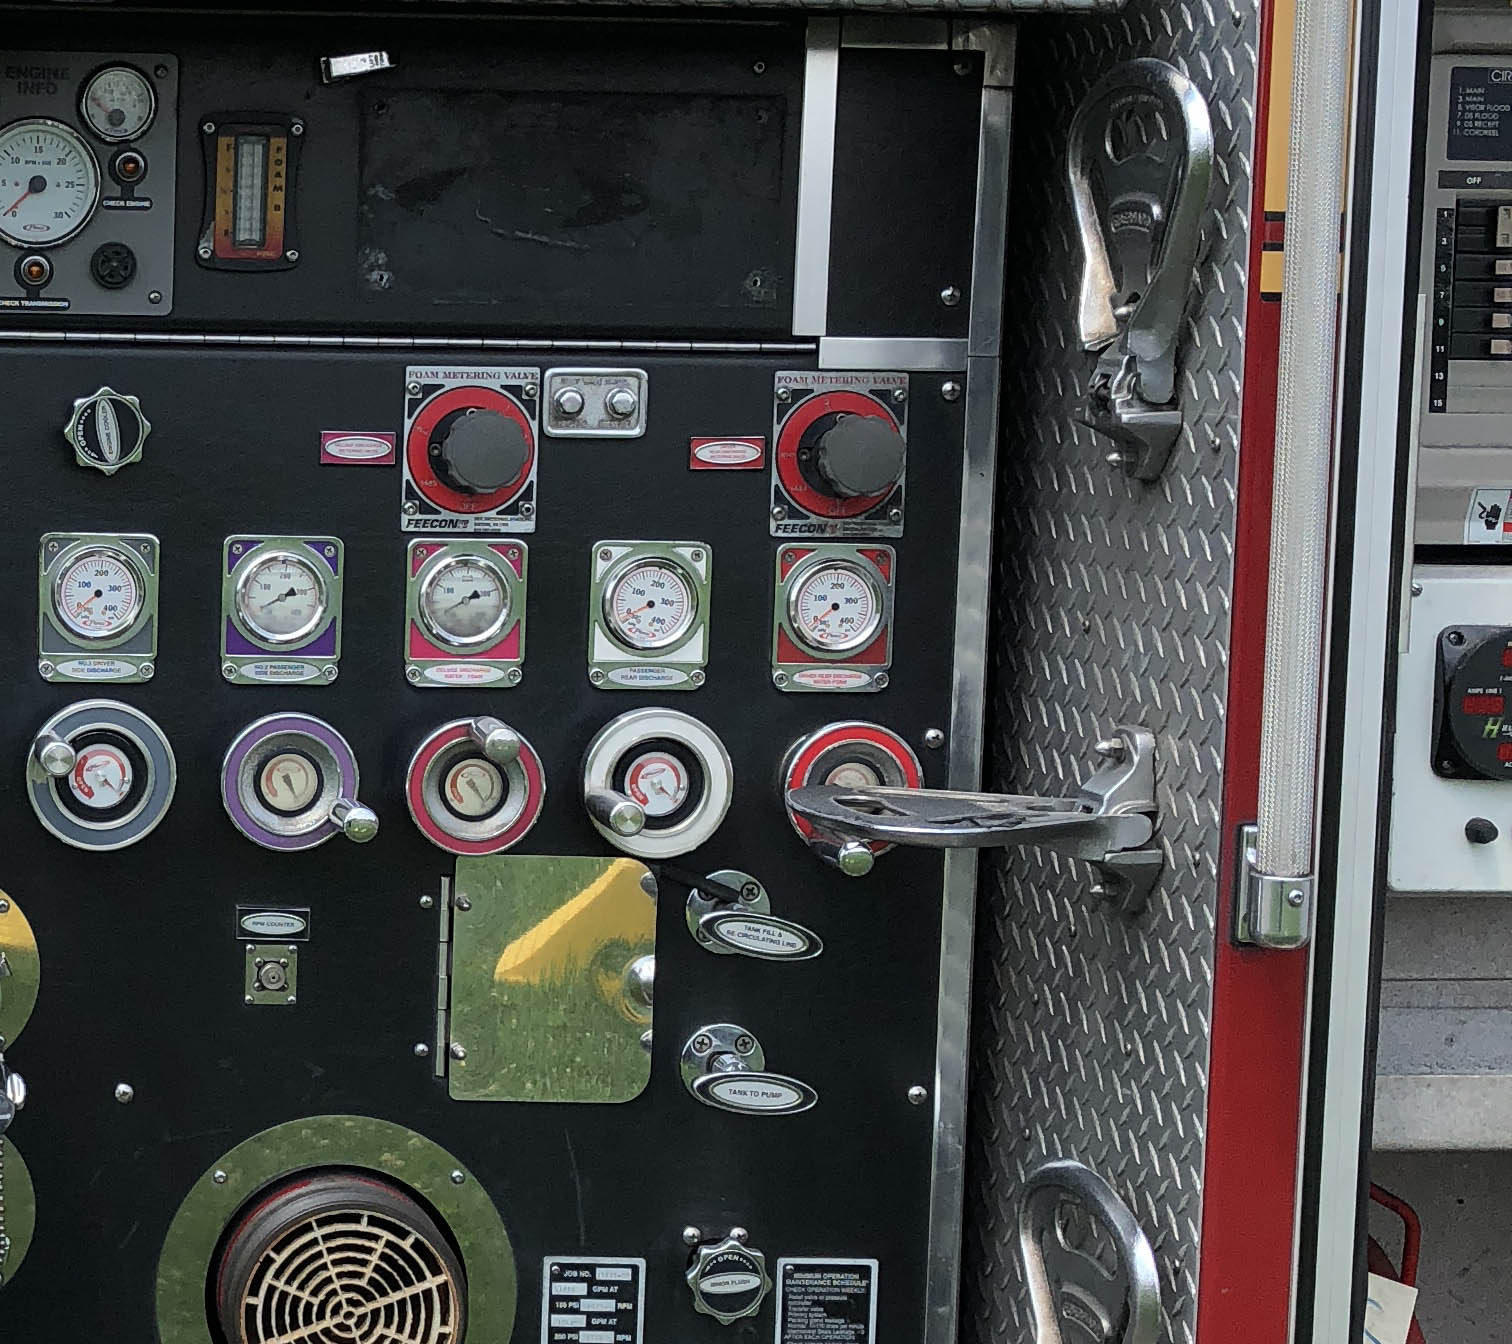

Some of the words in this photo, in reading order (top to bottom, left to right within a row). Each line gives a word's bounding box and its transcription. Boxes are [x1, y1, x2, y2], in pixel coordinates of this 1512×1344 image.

[4, 66, 70, 80] ENGINE
[17, 83, 57, 95] INFO
[34, 146, 43, 154] 15
[11, 157, 20, 165] 10
[57, 158, 66, 166] 20
[272, 146, 283, 192] FOAM
[65, 181, 75, 189] 25
[54, 211, 63, 219] 30
[408, 370, 439, 380] FOAM
[443, 371, 500, 381] METERING
[504, 371, 538, 380] VALVE
[777, 376, 808, 384] FOAM
[812, 376, 869, 385] METERING
[872, 376, 906, 385] VALVE
[78, 425, 86, 446] OPEN
[406, 519, 458, 529] FEECON
[775, 524, 826, 533] FEECON
[651, 580, 665, 589] 200
[744, 925, 761, 934] TANK
[762, 928, 776, 936] FILL
[737, 932, 781, 946] CIRCULATING
[782, 939, 797, 948] LINE
[729, 1088, 748, 1096] TANK
[717, 1254, 739, 1263] OPEN
